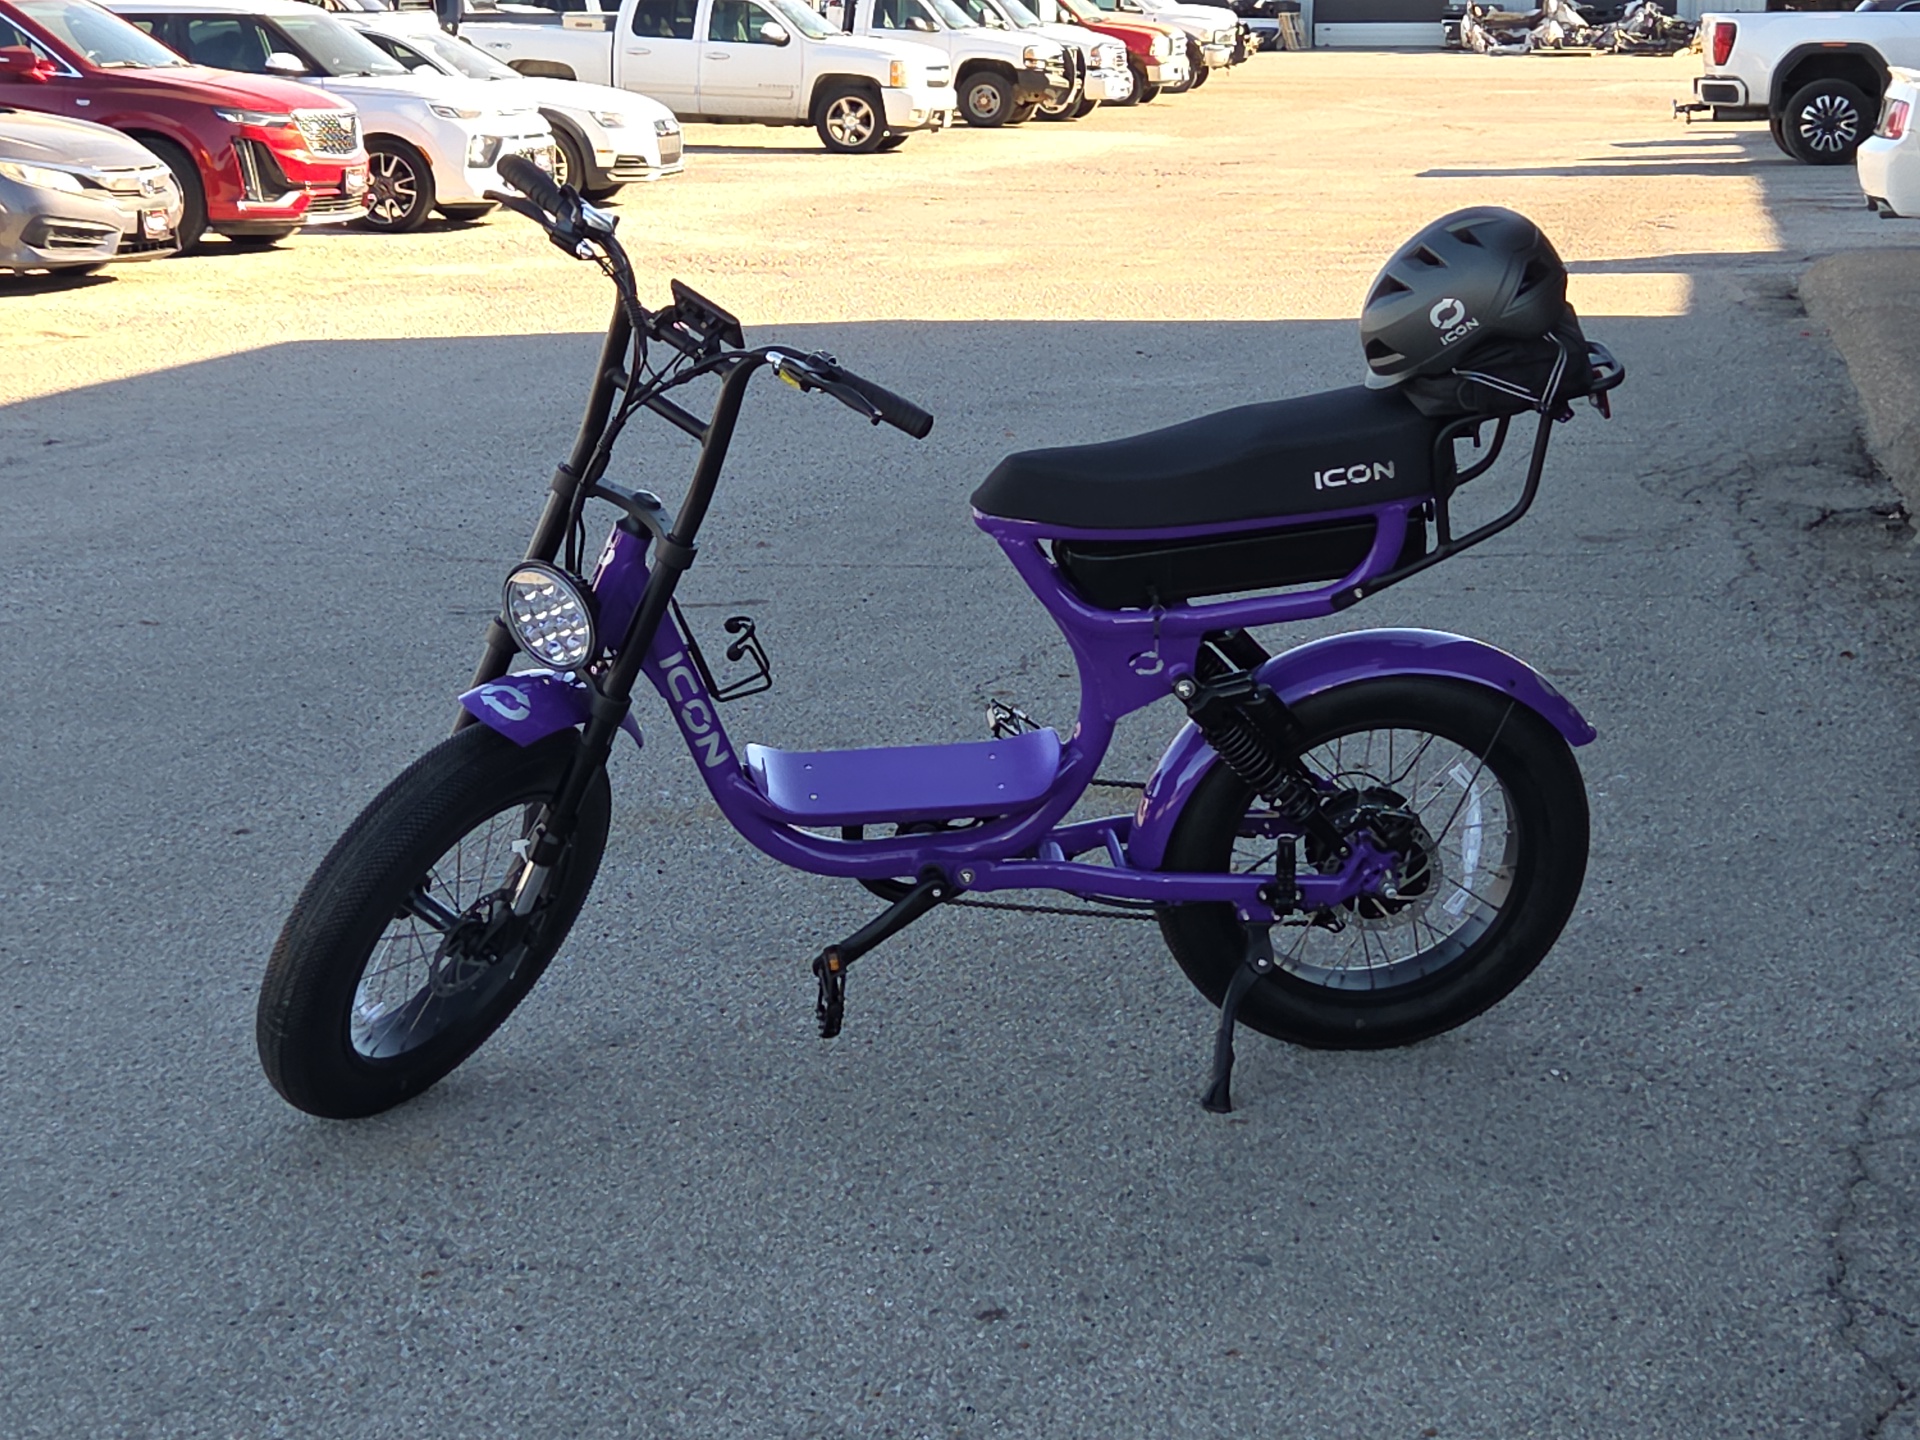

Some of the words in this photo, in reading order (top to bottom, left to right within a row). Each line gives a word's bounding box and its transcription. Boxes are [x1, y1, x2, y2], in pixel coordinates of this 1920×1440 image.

[1440, 317, 1479, 346] ICON
[1314, 460, 1395, 490] ICON
[658, 650, 731, 769] ICON
